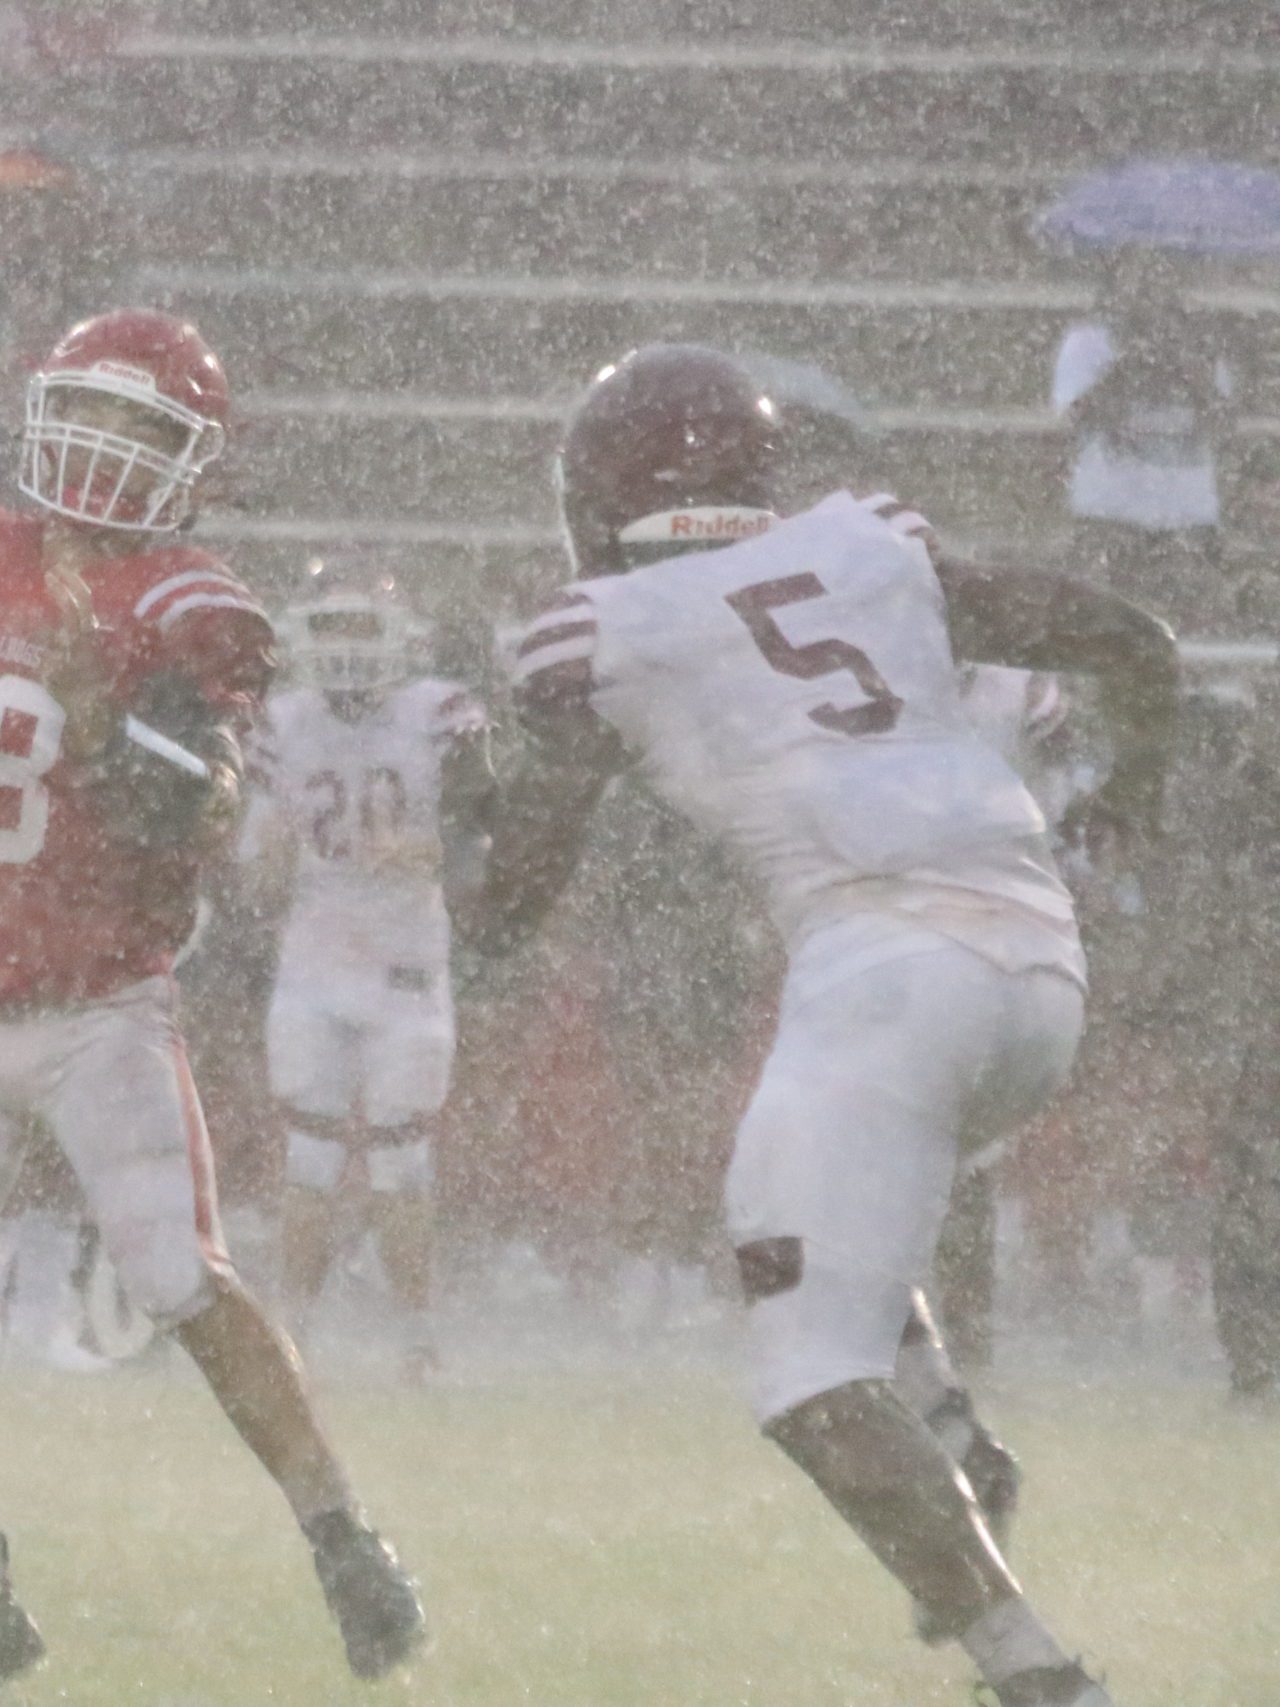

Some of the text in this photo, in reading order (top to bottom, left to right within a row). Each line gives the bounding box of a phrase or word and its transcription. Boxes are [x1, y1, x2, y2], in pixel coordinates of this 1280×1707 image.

[99, 362, 152, 385] Riddell
[671, 513, 770, 537] Riddell
[723, 571, 905, 736] 5
